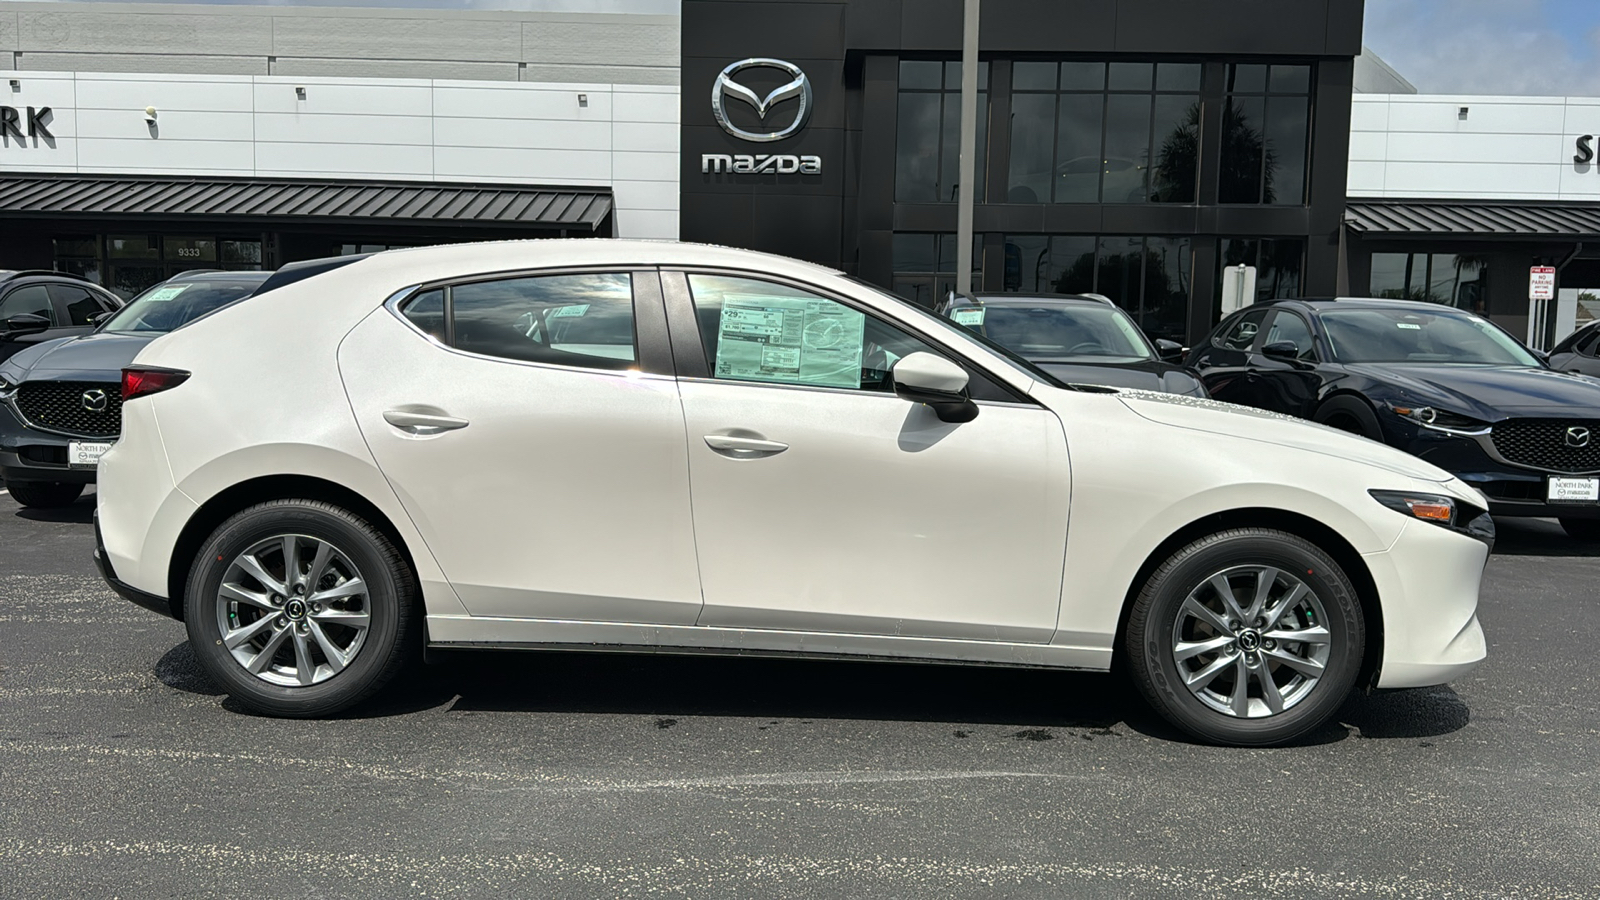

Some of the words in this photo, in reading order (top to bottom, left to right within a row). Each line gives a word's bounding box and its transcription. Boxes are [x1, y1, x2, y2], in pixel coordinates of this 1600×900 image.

[1573, 134, 1600, 163] S
[178, 247, 200, 257] 9333
[728, 310, 738, 318] 29
